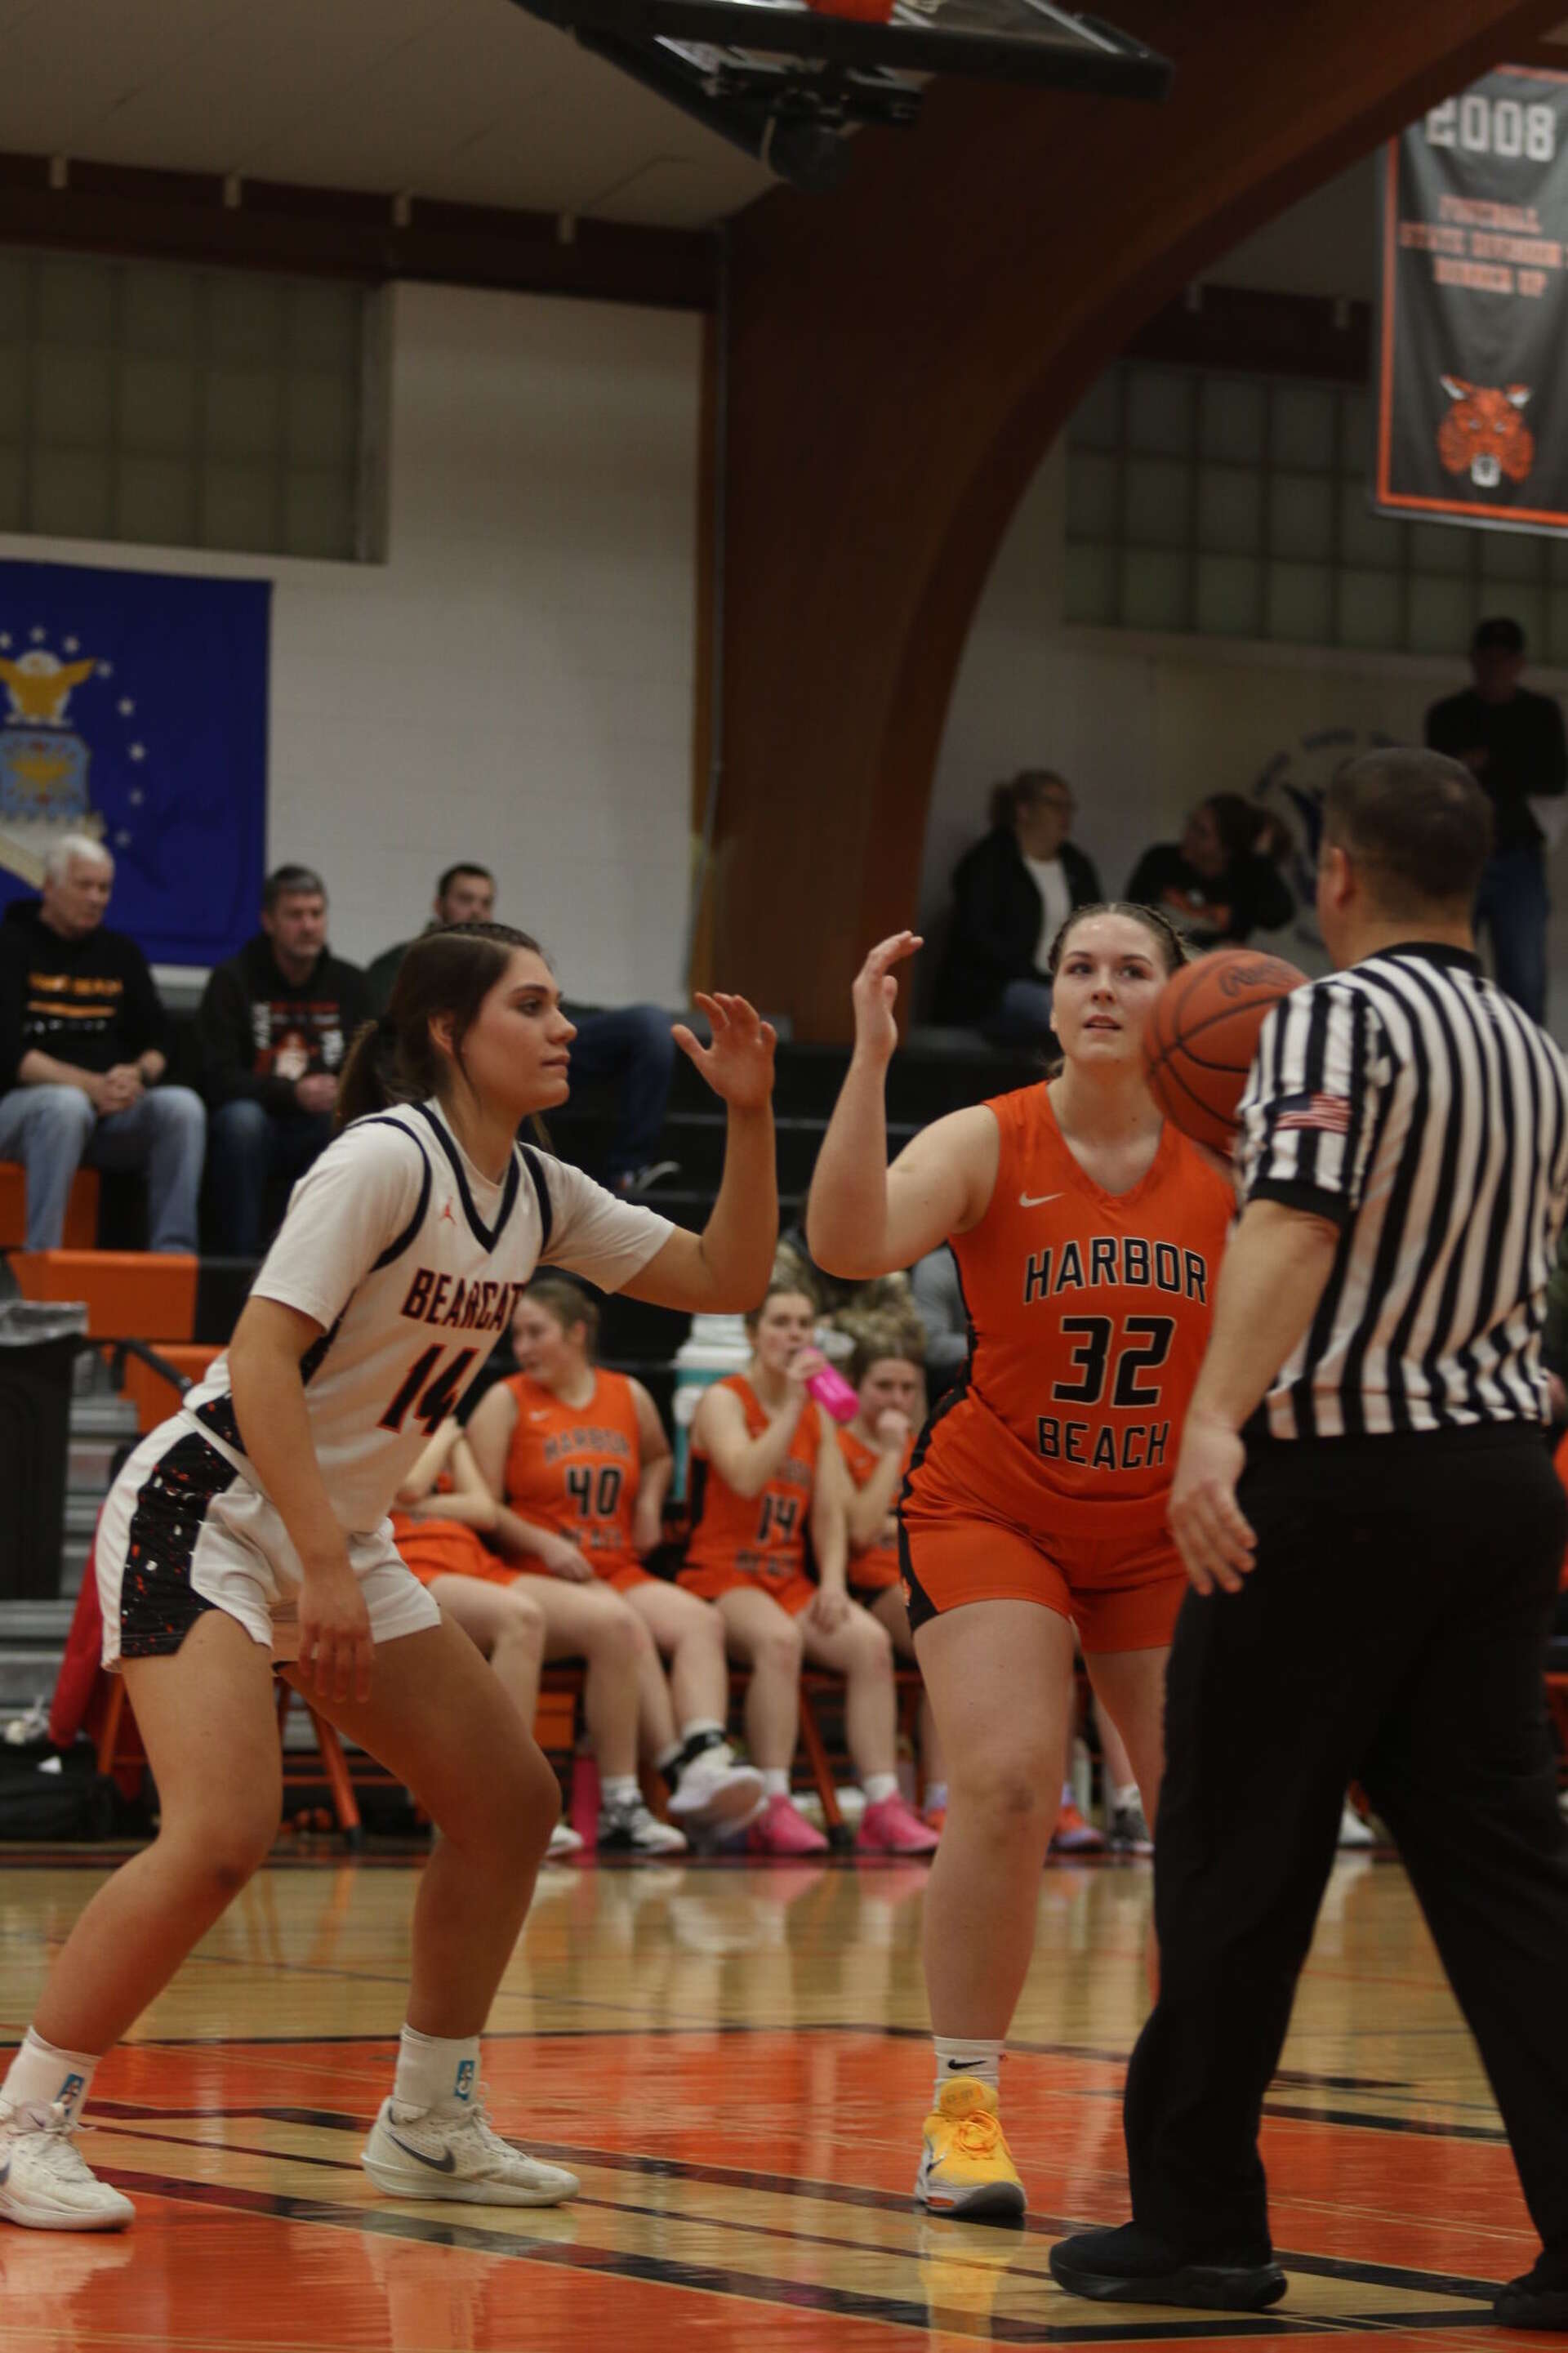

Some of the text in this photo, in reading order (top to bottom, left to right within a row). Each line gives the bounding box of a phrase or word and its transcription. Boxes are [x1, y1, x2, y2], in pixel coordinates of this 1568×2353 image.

[1426, 92, 1555, 163] 2008
[1023, 1236, 1207, 1306] HARBOR
[376, 1343, 480, 1438] 14
[1050, 1315, 1176, 1408] 32
[1036, 1414, 1170, 1471] BEACH
[564, 1464, 626, 1521] 40
[755, 1490, 799, 1546] 14
